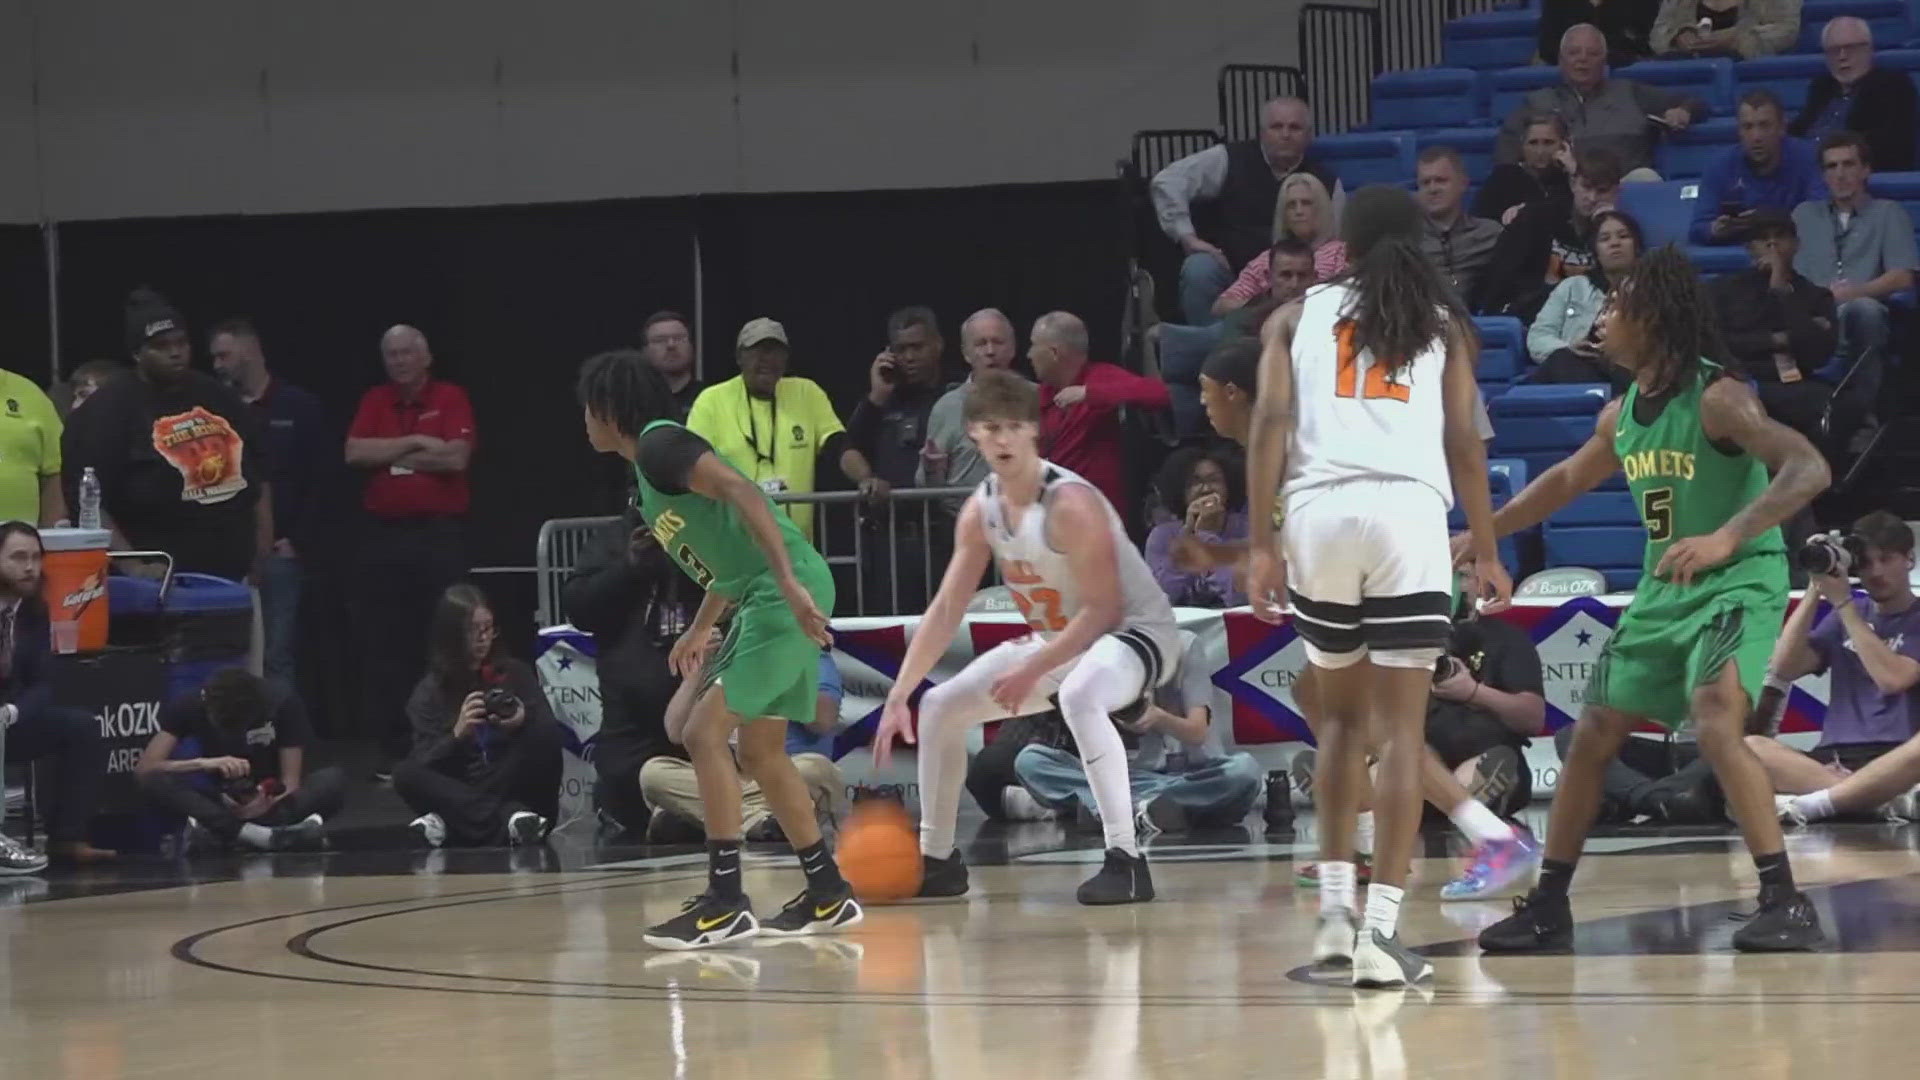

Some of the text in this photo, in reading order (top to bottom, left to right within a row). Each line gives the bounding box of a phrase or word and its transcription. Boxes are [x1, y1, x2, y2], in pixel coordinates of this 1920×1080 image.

[1332, 318, 1411, 404] 12
[1623, 449, 1695, 482] OMETS
[1643, 487, 1673, 542] 5
[677, 543, 716, 591] 3
[1540, 578, 1599, 594] Bank OZK
[984, 597, 1009, 611] Ban
[94, 701, 161, 738] nk OZK
[569, 711, 594, 726] NK
